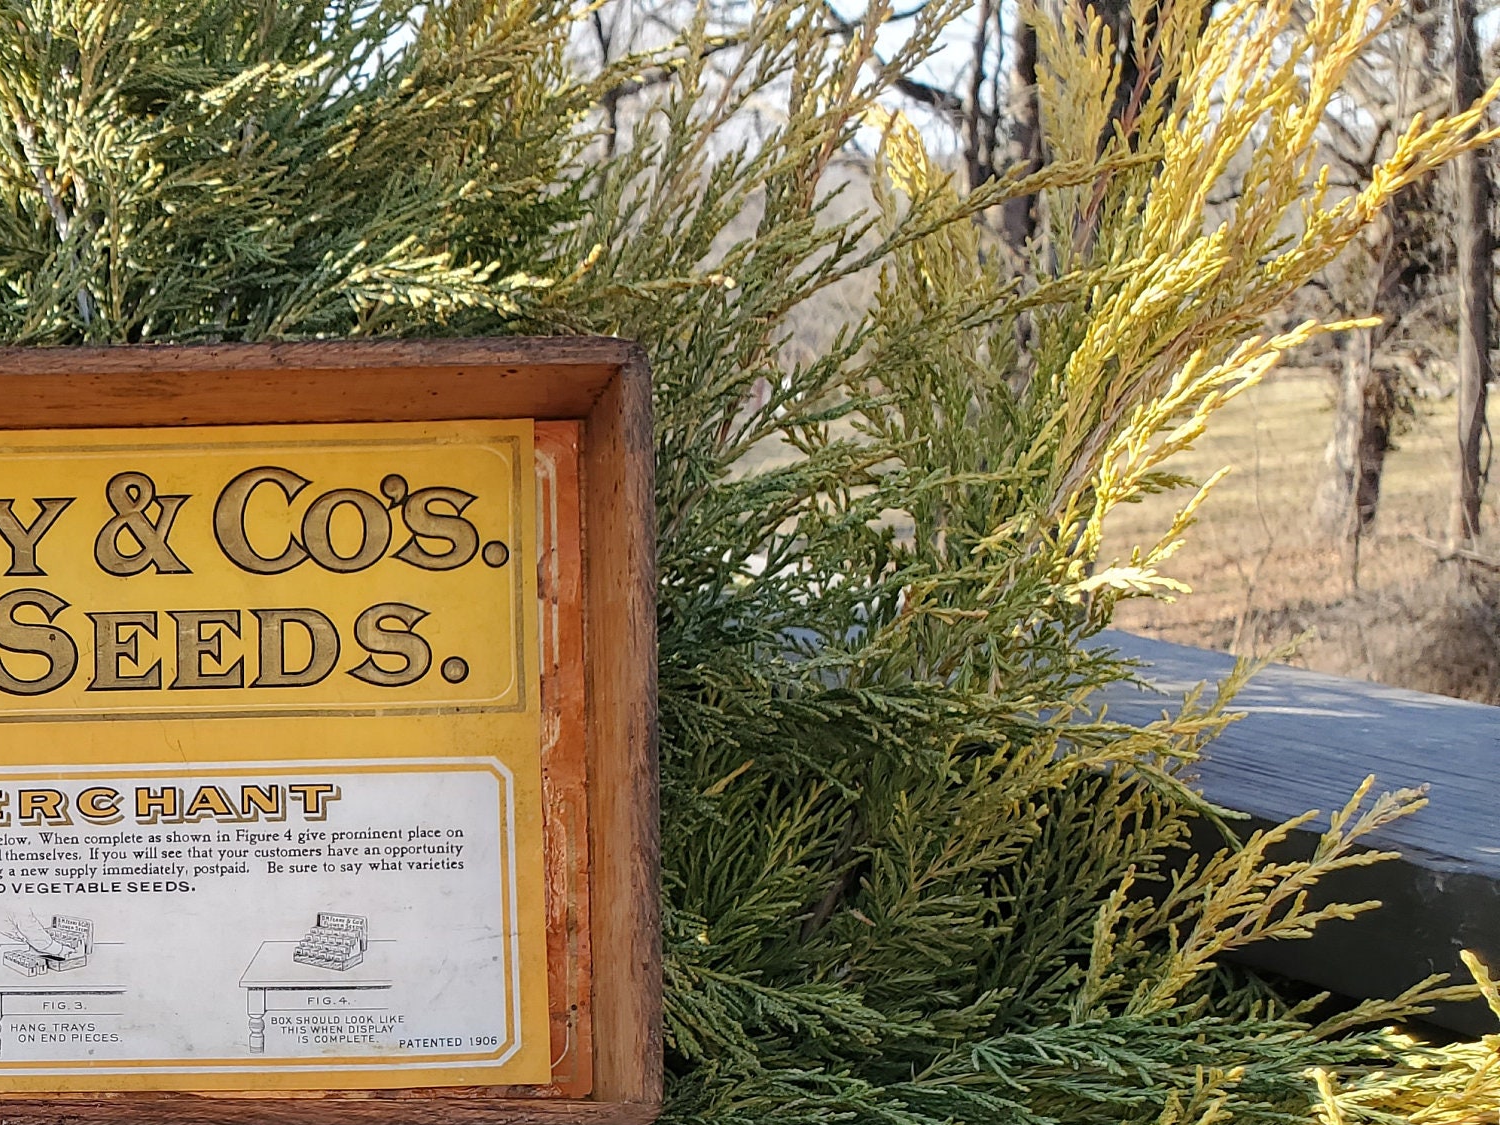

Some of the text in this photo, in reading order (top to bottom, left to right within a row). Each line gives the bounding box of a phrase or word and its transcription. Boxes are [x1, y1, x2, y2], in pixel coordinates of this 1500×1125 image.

[93, 471, 193, 578] &
[38, 832, 79, 844] When
[84, 831, 143, 846] complete
[147, 833, 162, 842] as
[165, 830, 211, 842] shown
[216, 830, 231, 841] in
[235, 829, 280, 844] Figure
[284, 829, 292, 841] 4
[297, 829, 326, 844] give
[331, 828, 403, 843] prominent
[407, 827, 441, 842] place
[446, 829, 464, 838] on
[89, 847, 99, 859] If
[101, 850, 127, 862] you
[133, 846, 158, 858] will
[161, 849, 182, 858] see
[187, 846, 213, 858] that
[217, 848, 249, 861] your
[254, 846, 322, 857] customers
[327, 844, 359, 856] have
[364, 846, 381, 855] an
[384, 843, 464, 858] opportunity
[8, 867, 16, 876] a
[20, 867, 50, 876] new
[54, 863, 97, 879] supply
[267, 860, 284, 872] Be
[288, 863, 318, 872] sure
[323, 861, 335, 872] to
[339, 862, 363, 875] say
[369, 859, 403, 871] what
[407, 859, 464, 870] varieties
[11, 882, 122, 893] VEGETABLE
[126, 881, 196, 893] SEEDS.
[270, 1014, 405, 1025] BOX SHOULD LOOK LIKE
[10, 1023, 96, 1033] HANG TRAYS
[280, 1024, 395, 1034] THIS WHEN DISPLAY
[18, 1033, 37, 1043] ON
[40, 1033, 67, 1043] END
[296, 1035, 310, 1045] IS
[398, 1035, 498, 1048] PATENTED 1906
